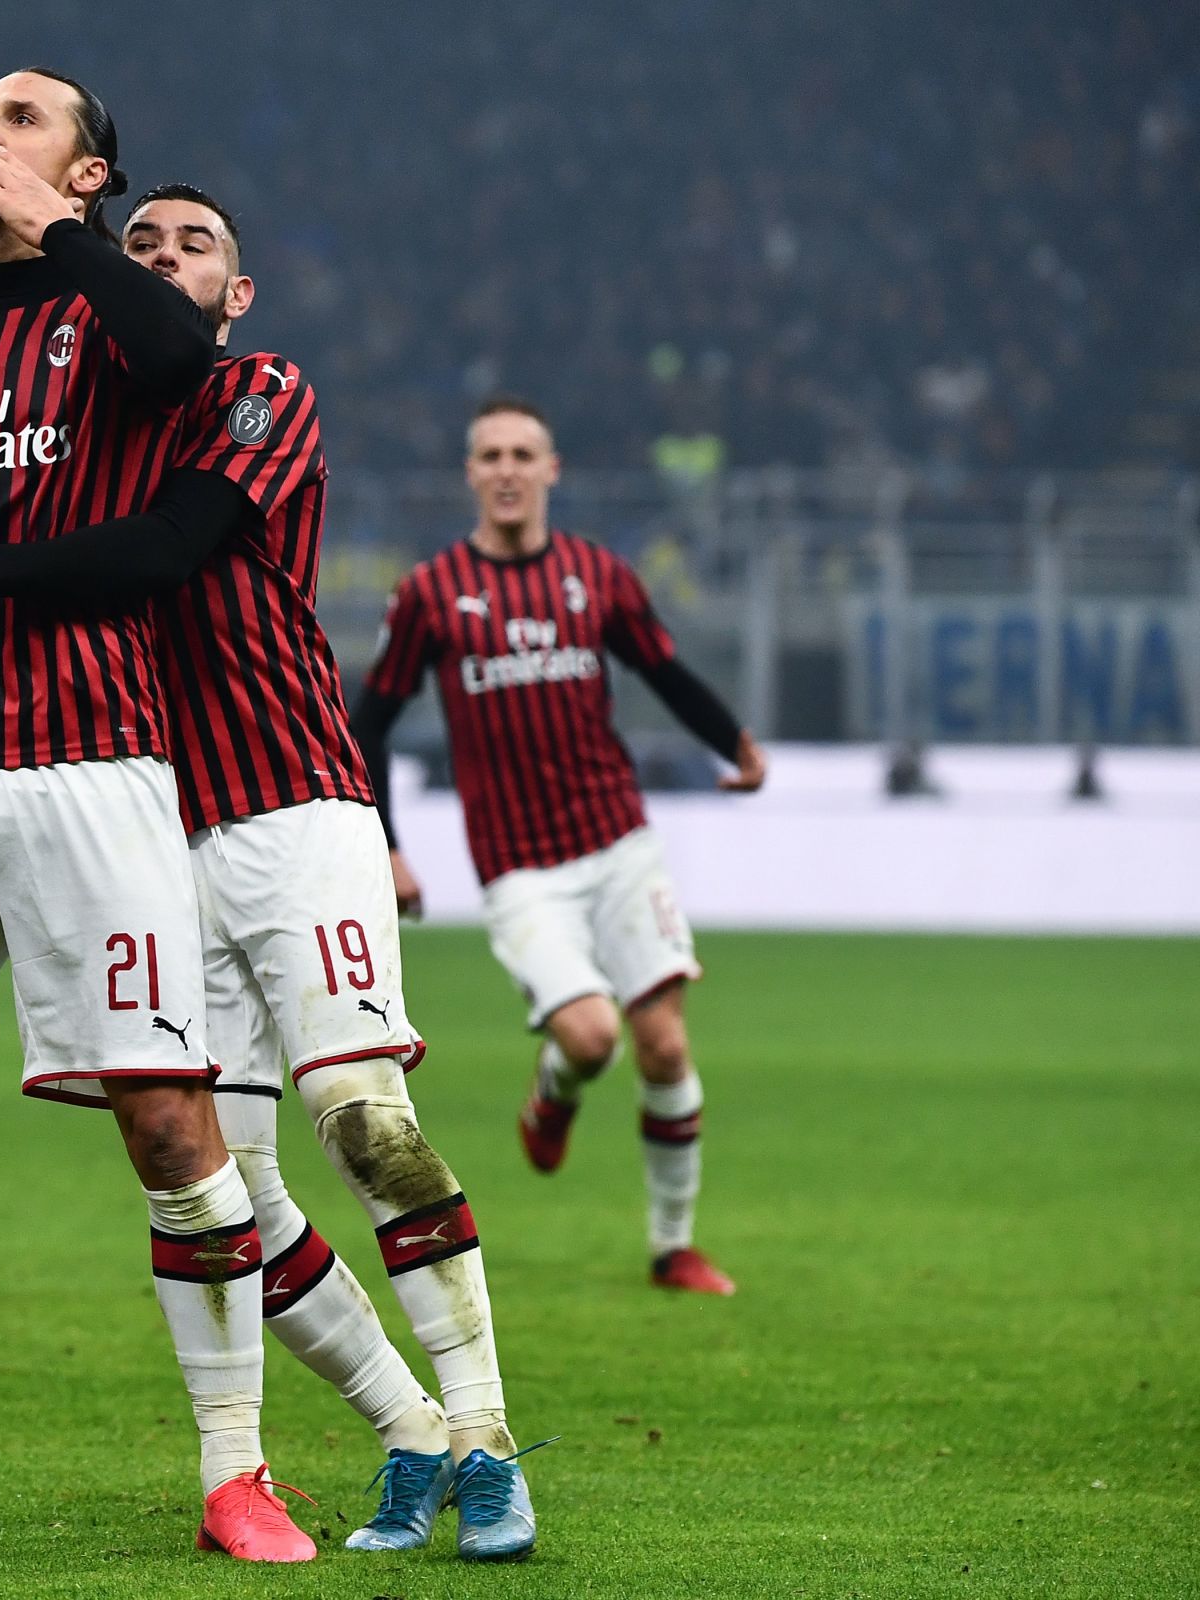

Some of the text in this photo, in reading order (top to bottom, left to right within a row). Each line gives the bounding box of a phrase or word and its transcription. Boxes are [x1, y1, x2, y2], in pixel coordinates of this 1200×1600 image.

[244, 417, 257, 430] 7
[106, 932, 160, 1010] 21
[315, 919, 375, 996] 19
